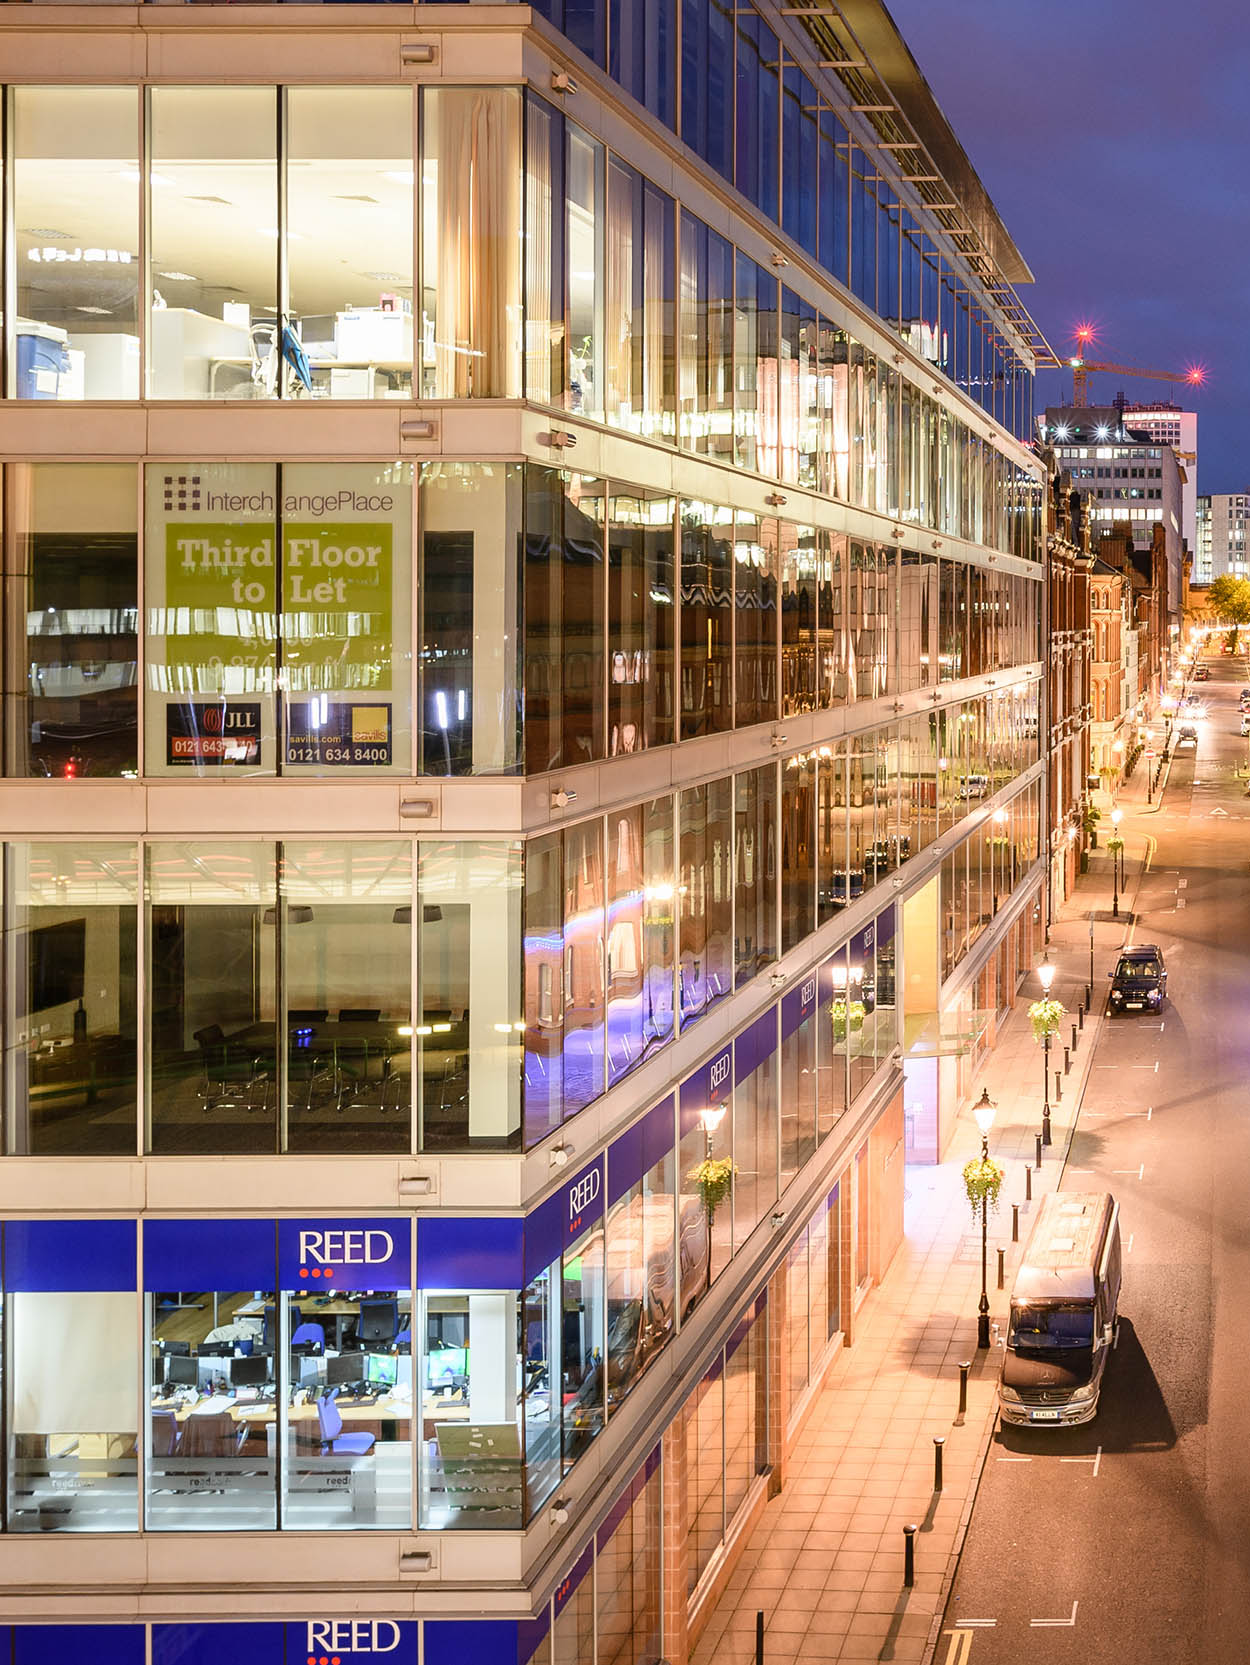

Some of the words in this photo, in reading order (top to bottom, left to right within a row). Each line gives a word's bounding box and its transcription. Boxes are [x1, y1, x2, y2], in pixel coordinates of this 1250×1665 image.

[177, 539, 273, 567] Third
[288, 539, 382, 567] Floor
[232, 576, 265, 603] to
[290, 575, 347, 603] Let
[226, 712, 256, 728] JLL
[175, 741, 200, 753] 0121
[289, 735, 342, 744] savills.com
[354, 727, 387, 742] savills
[289, 748, 321, 761] 0121
[325, 748, 351, 761] 634
[354, 748, 388, 761] 8400
[710, 1053, 730, 1091] REED
[570, 1168, 600, 1220] REED
[299, 1230, 394, 1265] REED
[307, 1619, 401, 1653] REED
